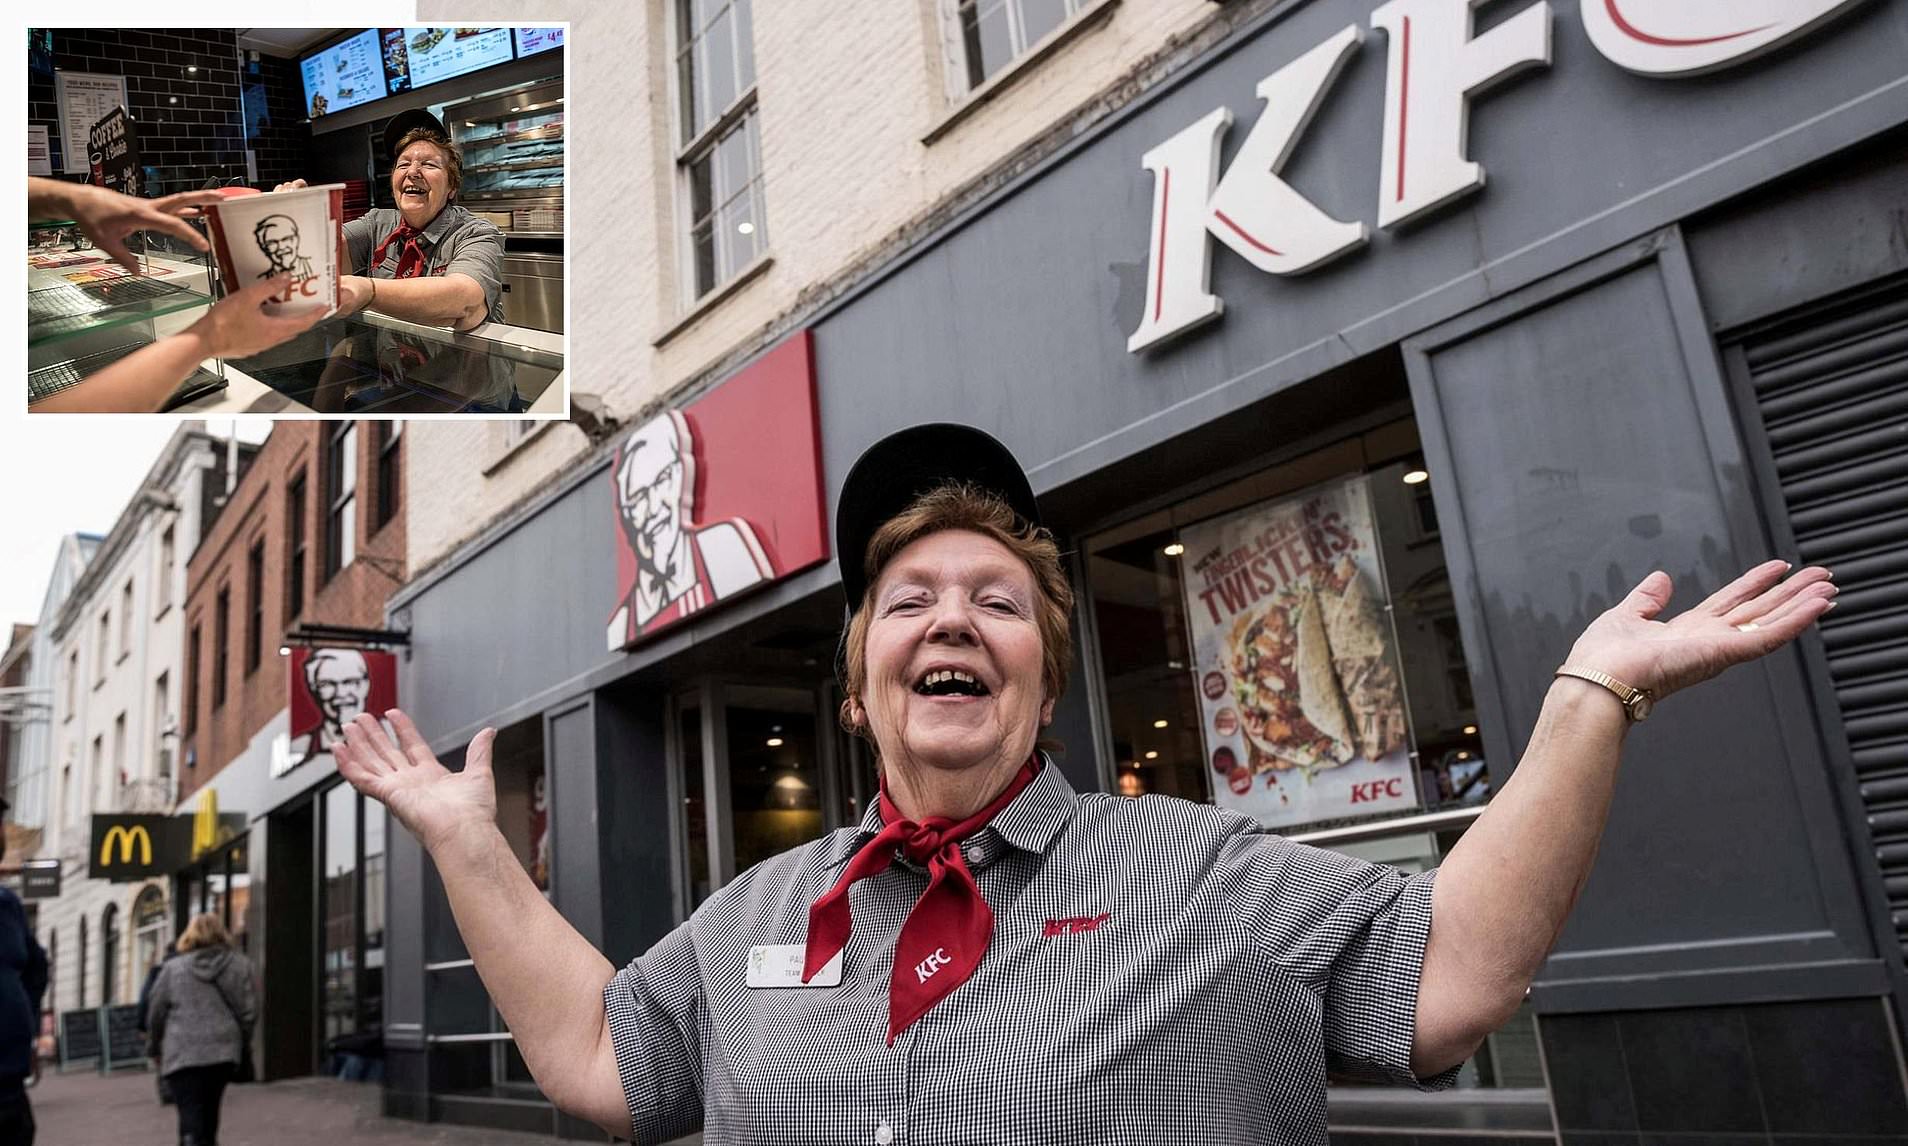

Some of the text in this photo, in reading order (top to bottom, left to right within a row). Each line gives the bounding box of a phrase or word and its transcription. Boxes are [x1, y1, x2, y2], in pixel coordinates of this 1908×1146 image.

[91, 113, 125, 150] COFFEE
[1350, 777, 1403, 804] KFC
[914, 947, 952, 984] KFC
